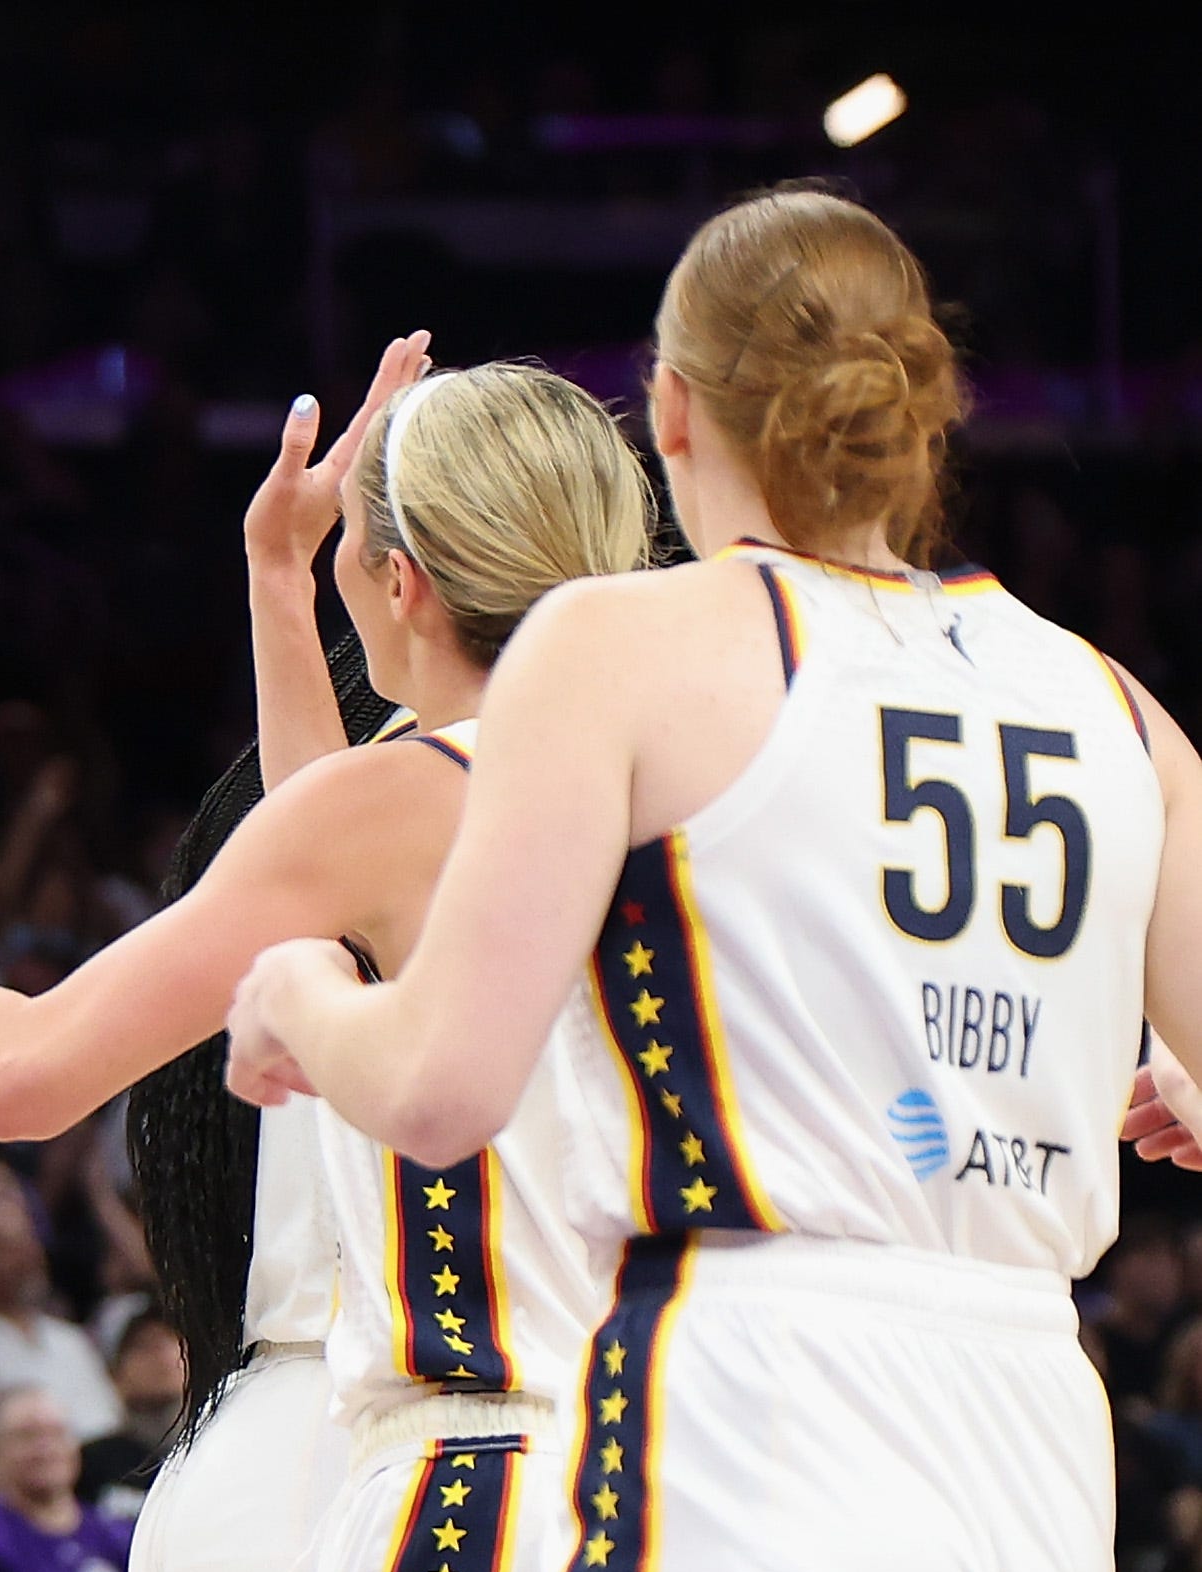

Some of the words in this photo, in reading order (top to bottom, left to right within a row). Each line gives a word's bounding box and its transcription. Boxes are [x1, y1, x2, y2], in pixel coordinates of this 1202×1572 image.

[878, 704, 1093, 961] 55
[922, 982, 1042, 1079] BIBBY
[955, 1128, 1072, 1195] AT&T
